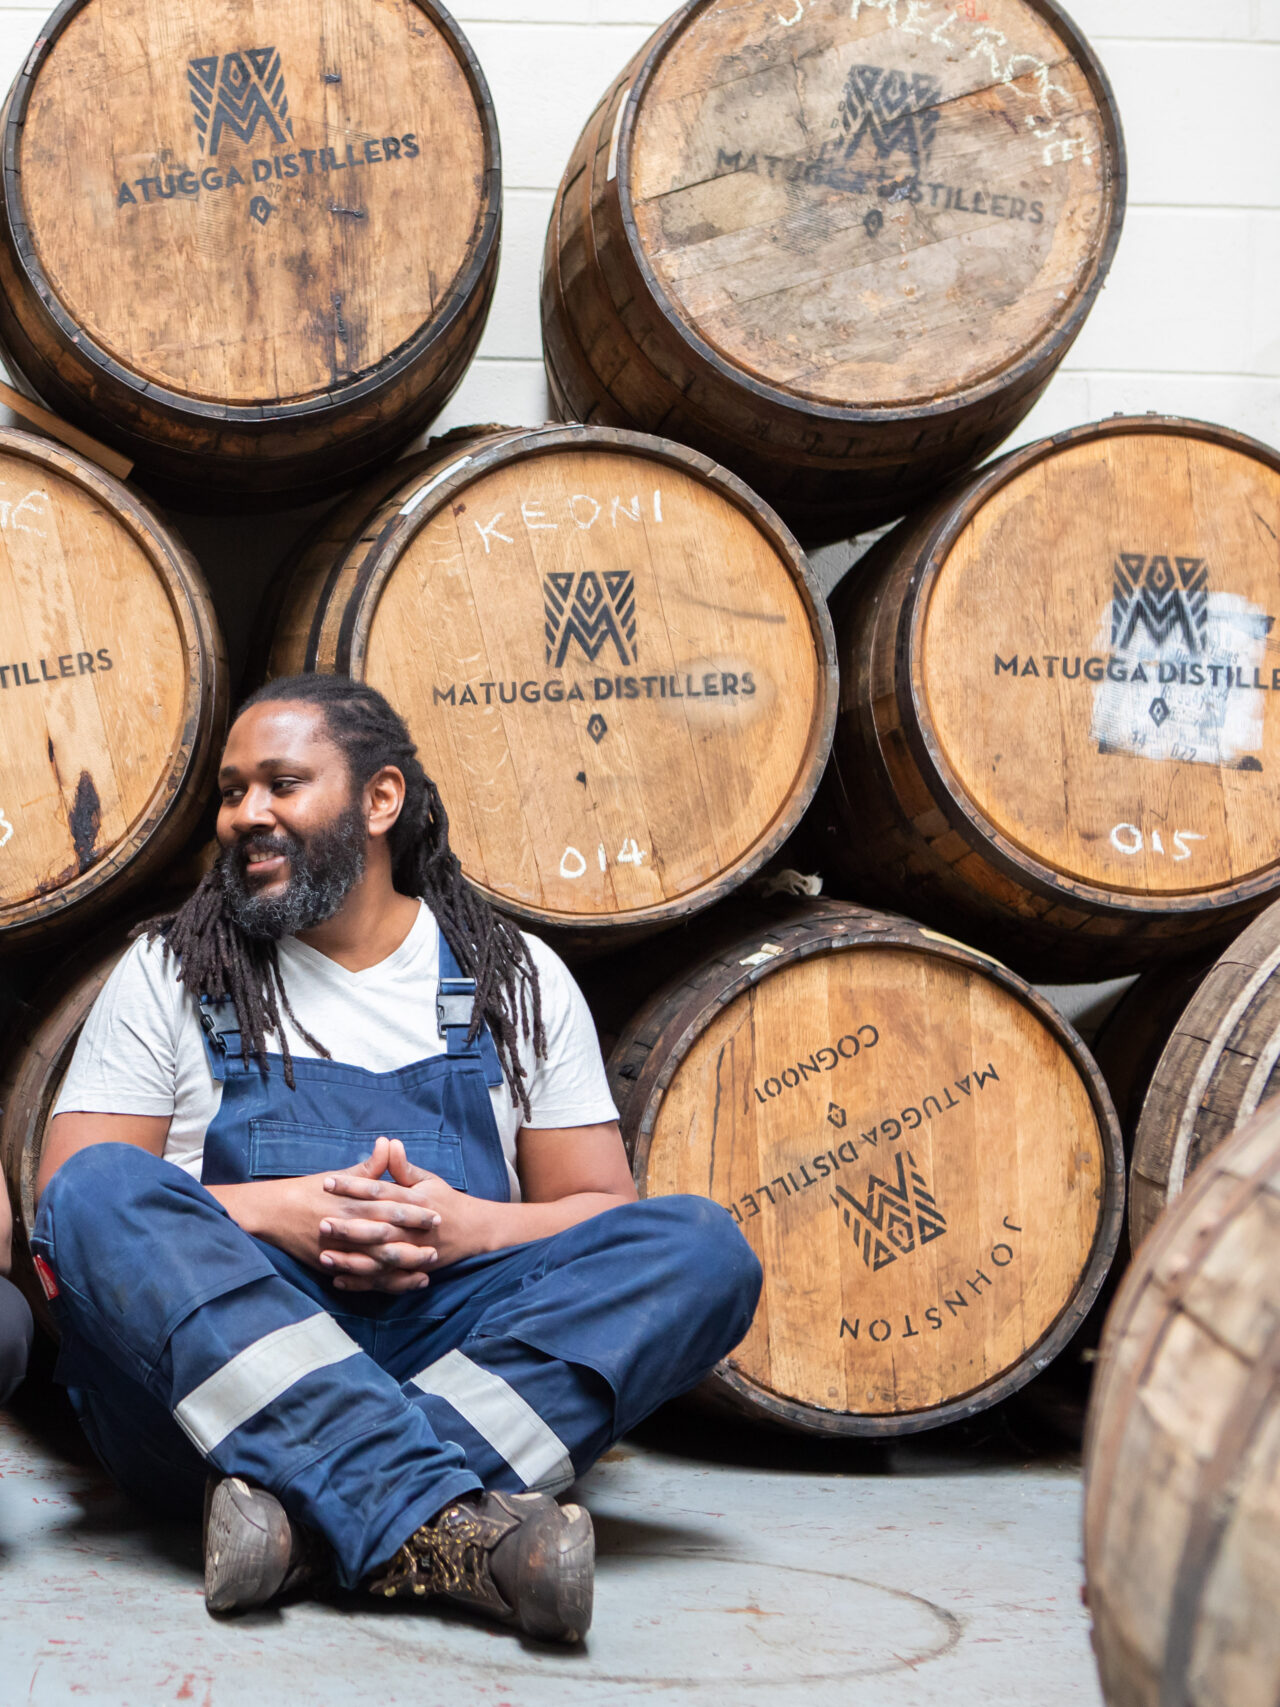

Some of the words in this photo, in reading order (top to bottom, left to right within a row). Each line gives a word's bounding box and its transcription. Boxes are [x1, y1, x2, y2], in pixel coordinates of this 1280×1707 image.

[252, 132, 420, 184] DISTILLERS
[472, 489, 664, 554] KEONI
[431, 679, 585, 708] MATUGGA
[593, 671, 757, 702] DISTILLERS
[993, 653, 1149, 685] MATUGGA
[558, 838, 647, 879] 014
[1109, 822, 1208, 862] 015
[861, 1062, 1001, 1148] MATUGGA
